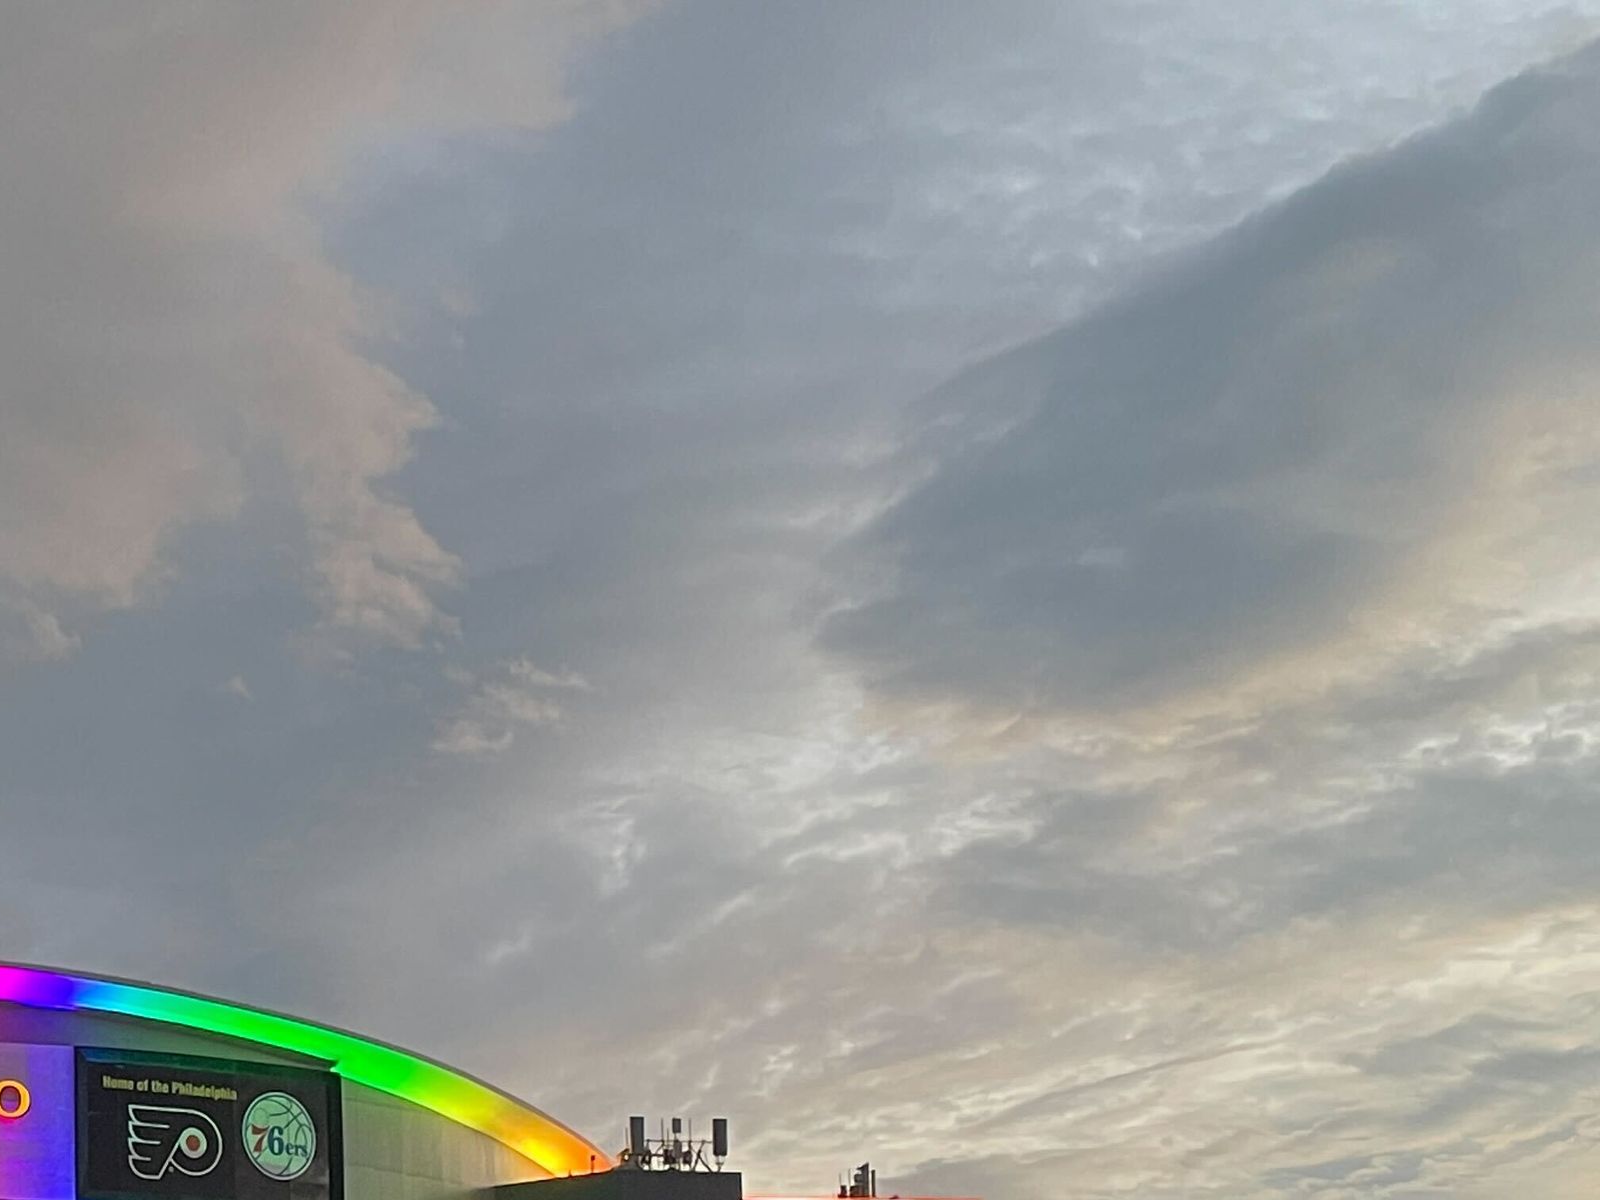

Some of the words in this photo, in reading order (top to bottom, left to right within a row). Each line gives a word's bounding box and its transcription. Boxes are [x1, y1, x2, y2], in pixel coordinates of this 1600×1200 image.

[102, 1075, 134, 1090] Home
[136, 1079, 149, 1091] of
[151, 1080, 169, 1094] the
[172, 1081, 238, 1101] Philadelphia
[250, 1124, 309, 1159] 76ers
